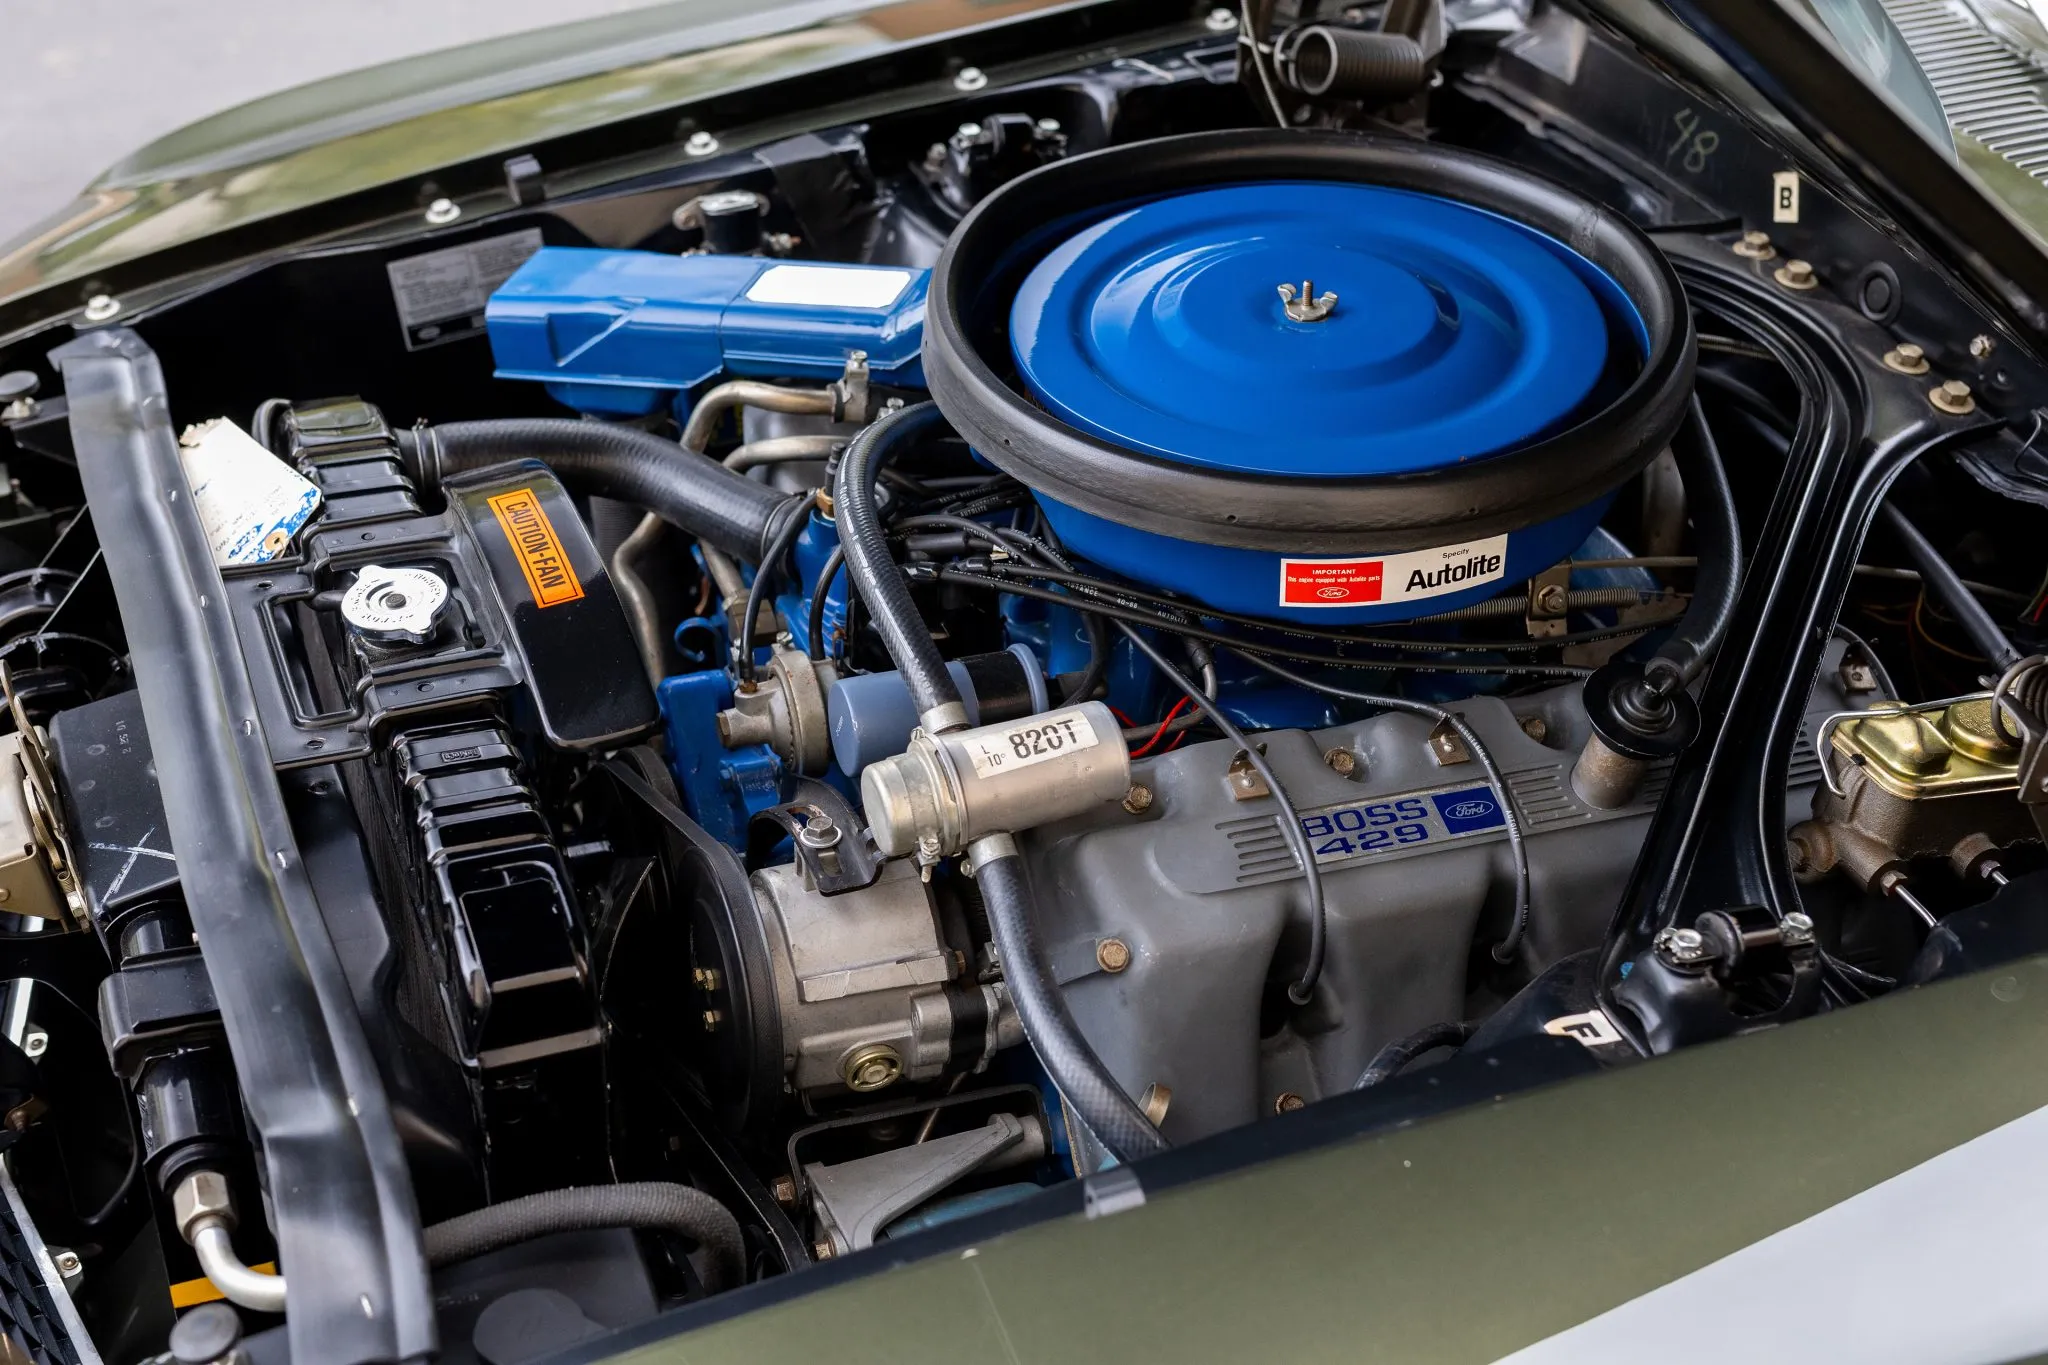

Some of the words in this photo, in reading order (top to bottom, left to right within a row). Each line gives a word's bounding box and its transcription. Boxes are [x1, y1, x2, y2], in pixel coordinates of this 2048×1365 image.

[1665, 108, 1720, 173] 48
[1779, 186, 1793, 209] B
[505, 501, 567, 589] CAUTION-FAN
[1442, 548, 1470, 559] Specify
[1404, 554, 1501, 593] Autolite
[980, 744, 991, 755] L
[1008, 719, 1077, 759] 820T
[1301, 799, 1429, 838] BOSS
[1316, 824, 1429, 855] 429
[1562, 1022, 1602, 1038] F
